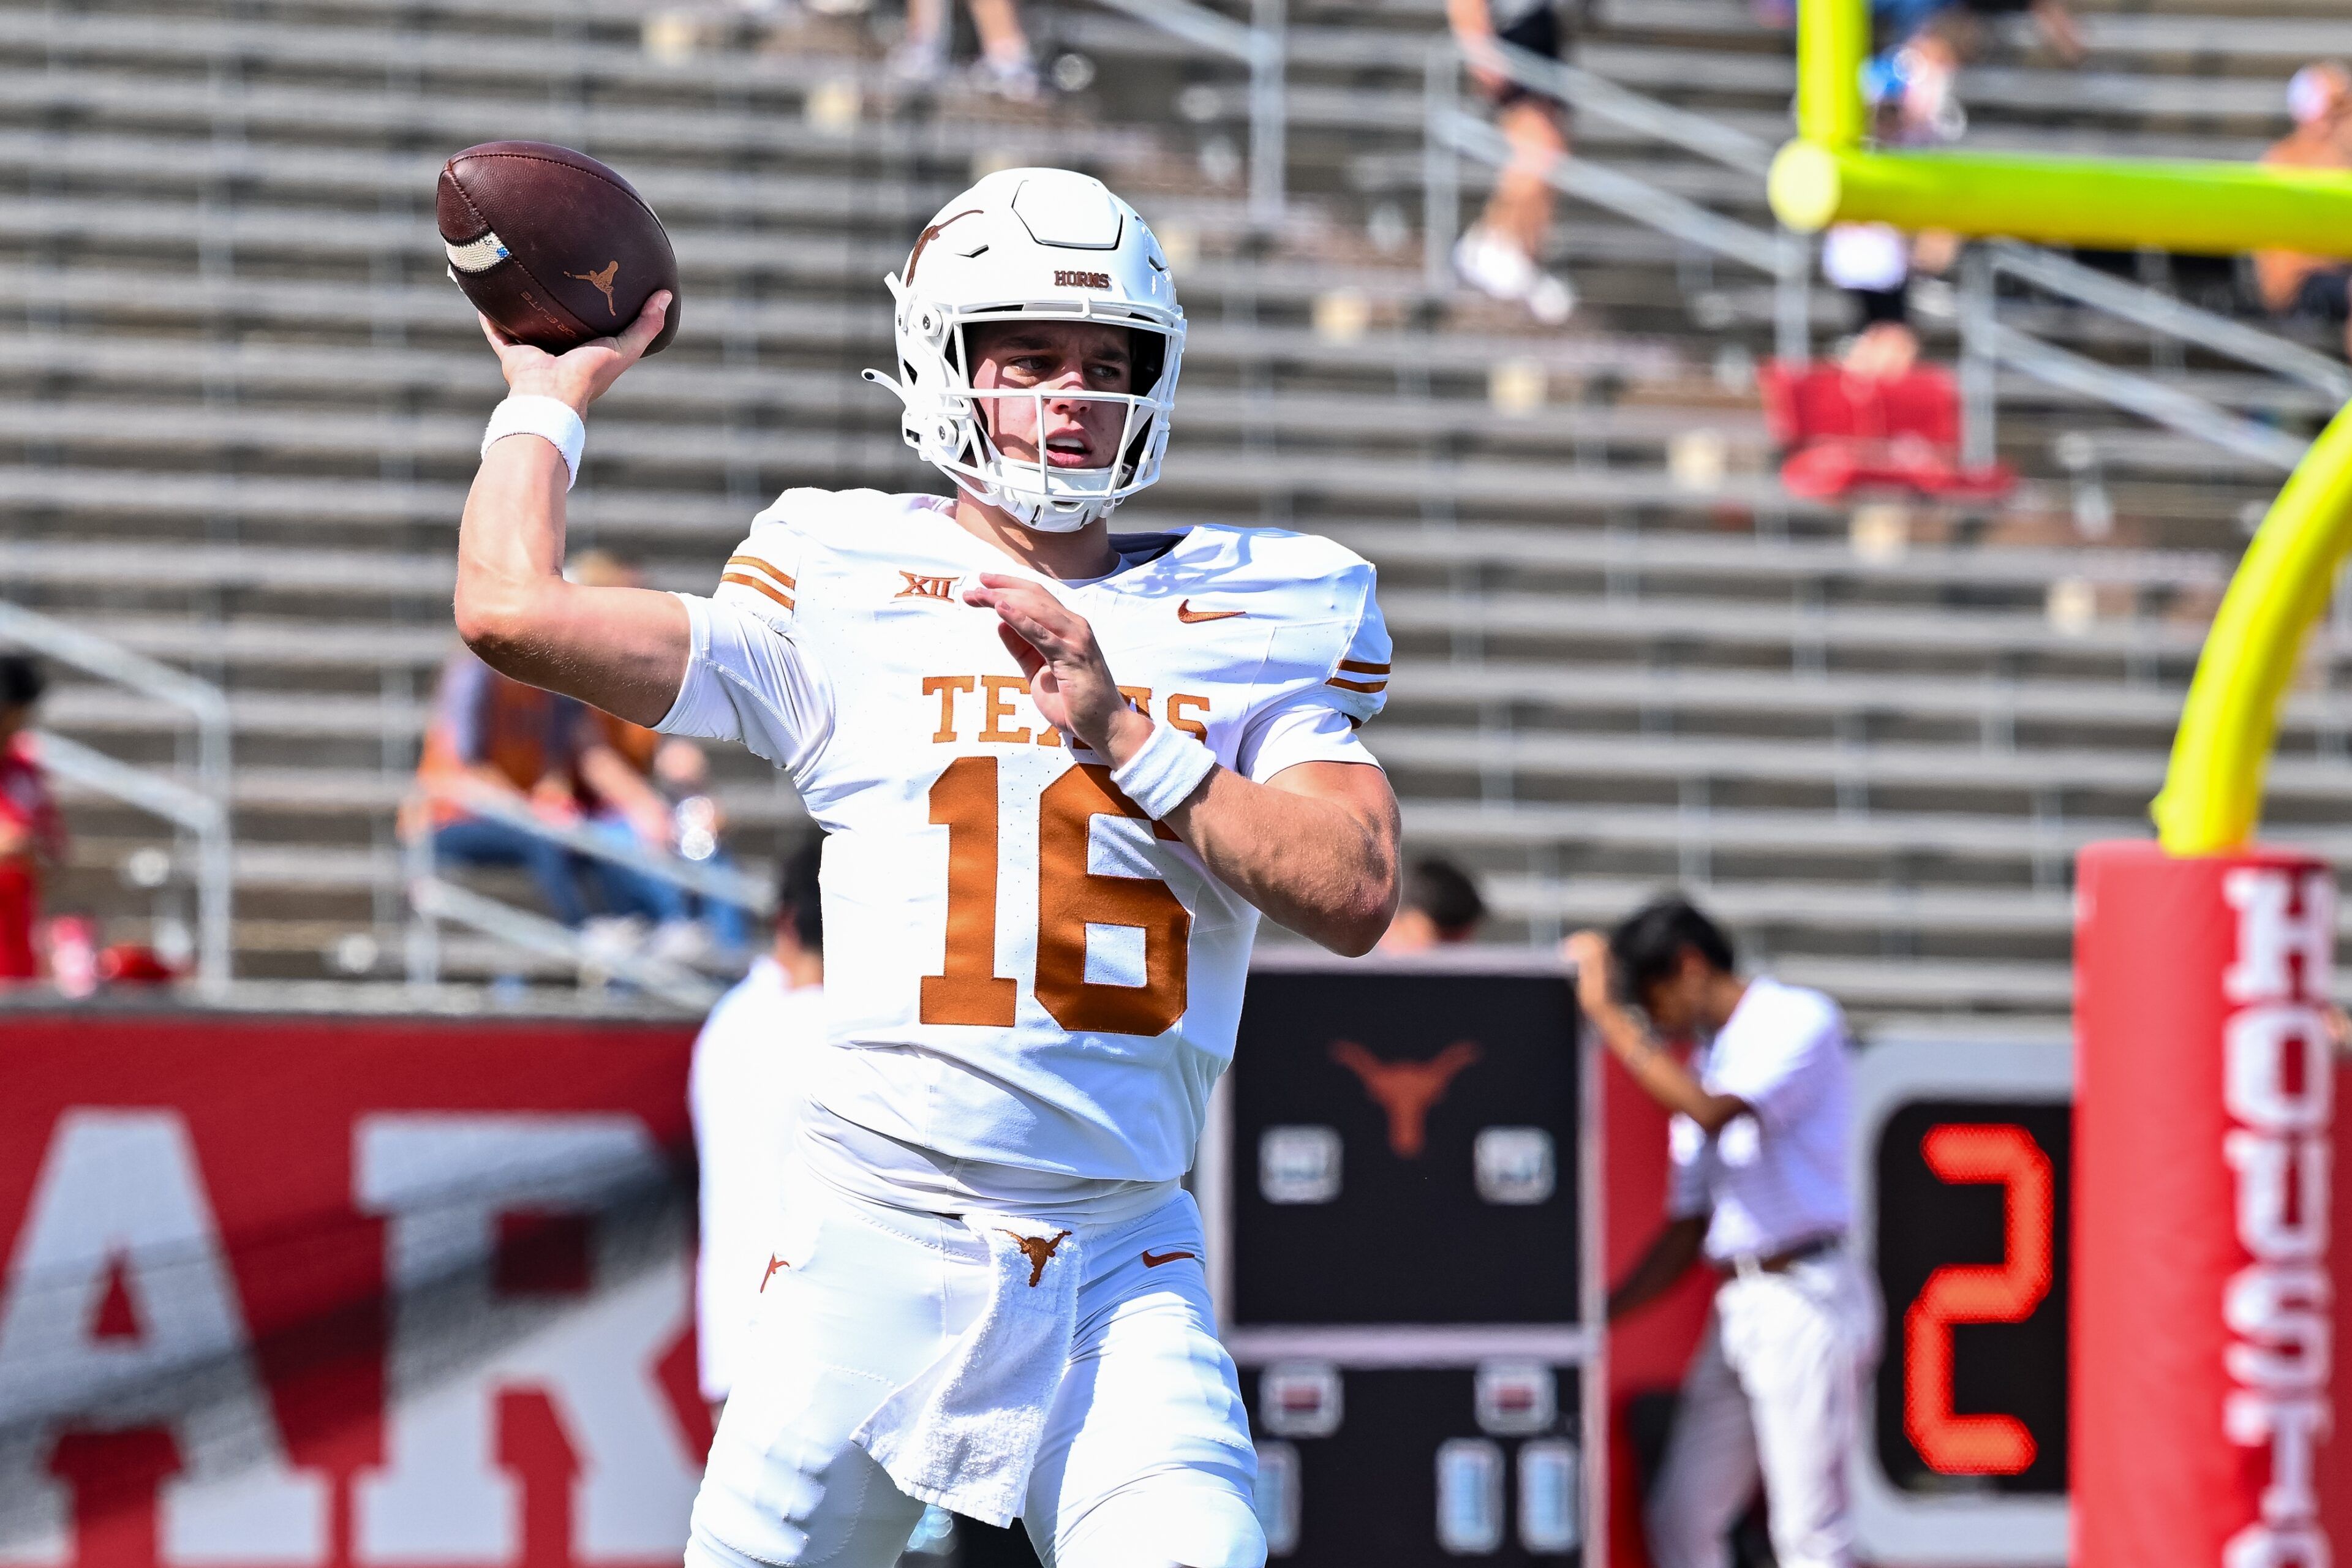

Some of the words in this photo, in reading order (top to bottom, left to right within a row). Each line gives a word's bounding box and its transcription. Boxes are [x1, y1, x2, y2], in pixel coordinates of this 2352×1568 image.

[1054, 270, 1109, 289] HORNS
[894, 570, 960, 603] XII
[920, 756, 1191, 1038] 16
[1904, 1123, 2054, 1476] 2
